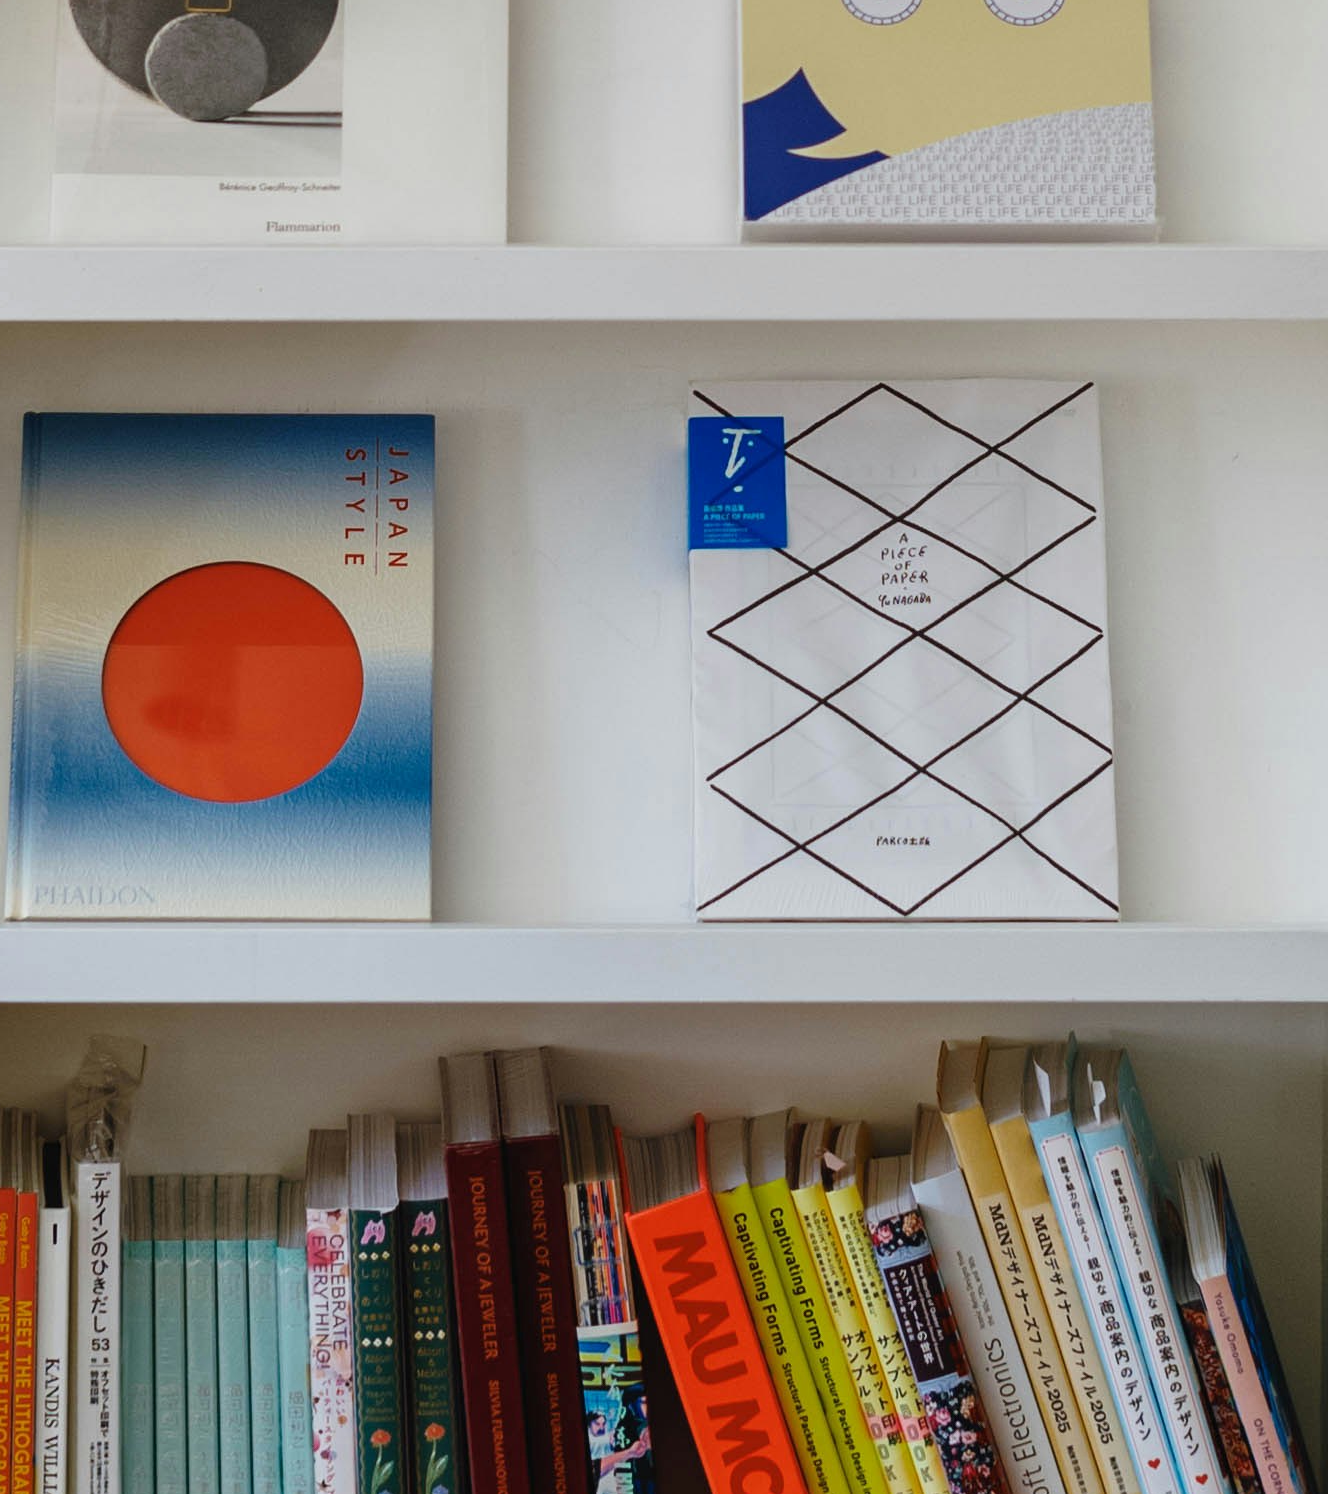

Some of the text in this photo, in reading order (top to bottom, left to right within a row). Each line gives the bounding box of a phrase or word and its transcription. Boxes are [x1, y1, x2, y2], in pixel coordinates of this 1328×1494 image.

[344, 447, 367, 567] STYLE
[387, 445, 409, 571] JAPAN
[880, 545, 928, 560] PIECE
[881, 570, 929, 585] PAPER
[894, 560, 912, 571] OF
[654, 1230, 752, 1387] MAU
